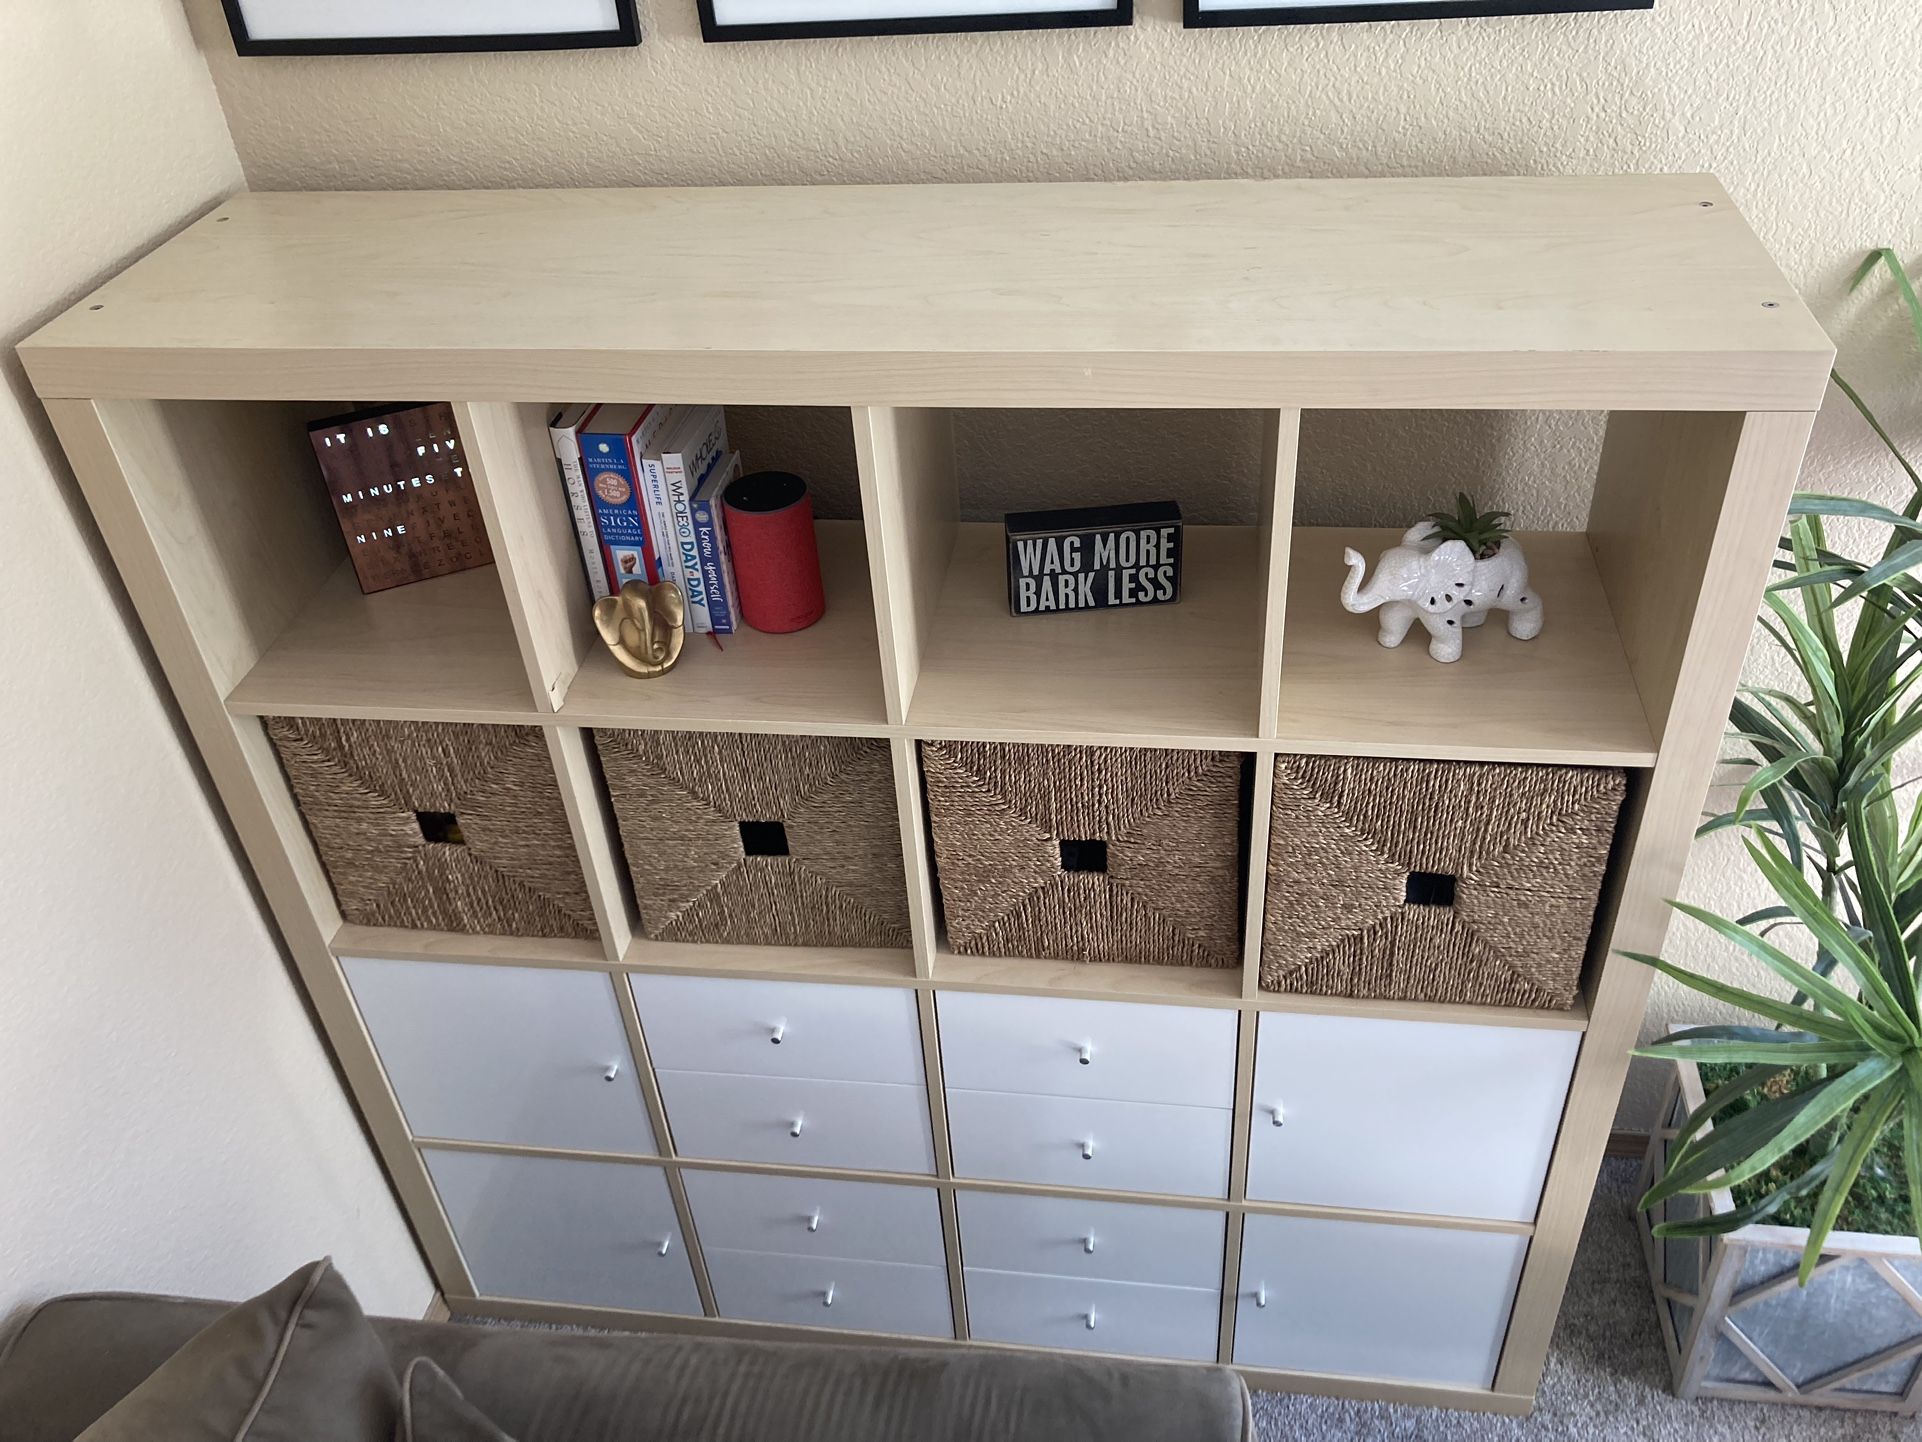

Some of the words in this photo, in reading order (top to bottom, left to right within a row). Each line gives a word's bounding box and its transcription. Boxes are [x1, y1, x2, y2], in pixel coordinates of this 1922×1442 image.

[324, 433, 346, 447] IT
[366, 423, 390, 438] IS
[416, 439, 456, 456] FIV
[342, 474, 435, 503] MINUTES
[563, 463, 588, 537] HORSES
[648, 463, 663, 506] SUPERLIFE
[600, 515, 639, 526] SIGN
[670, 479, 692, 538] WHOLE30
[356, 525, 406, 544] NINE
[602, 527, 642, 535] LANGUAGE
[603, 534, 643, 542] DICTIONARY
[680, 541, 699, 572] DAY
[1016, 535, 1081, 577] WAG
[1093, 527, 1176, 571] MORE
[687, 577, 706, 608] DAY
[703, 562, 724, 602] yourself
[1018, 571, 1096, 613] BARK
[1107, 565, 1174, 606] LESS
